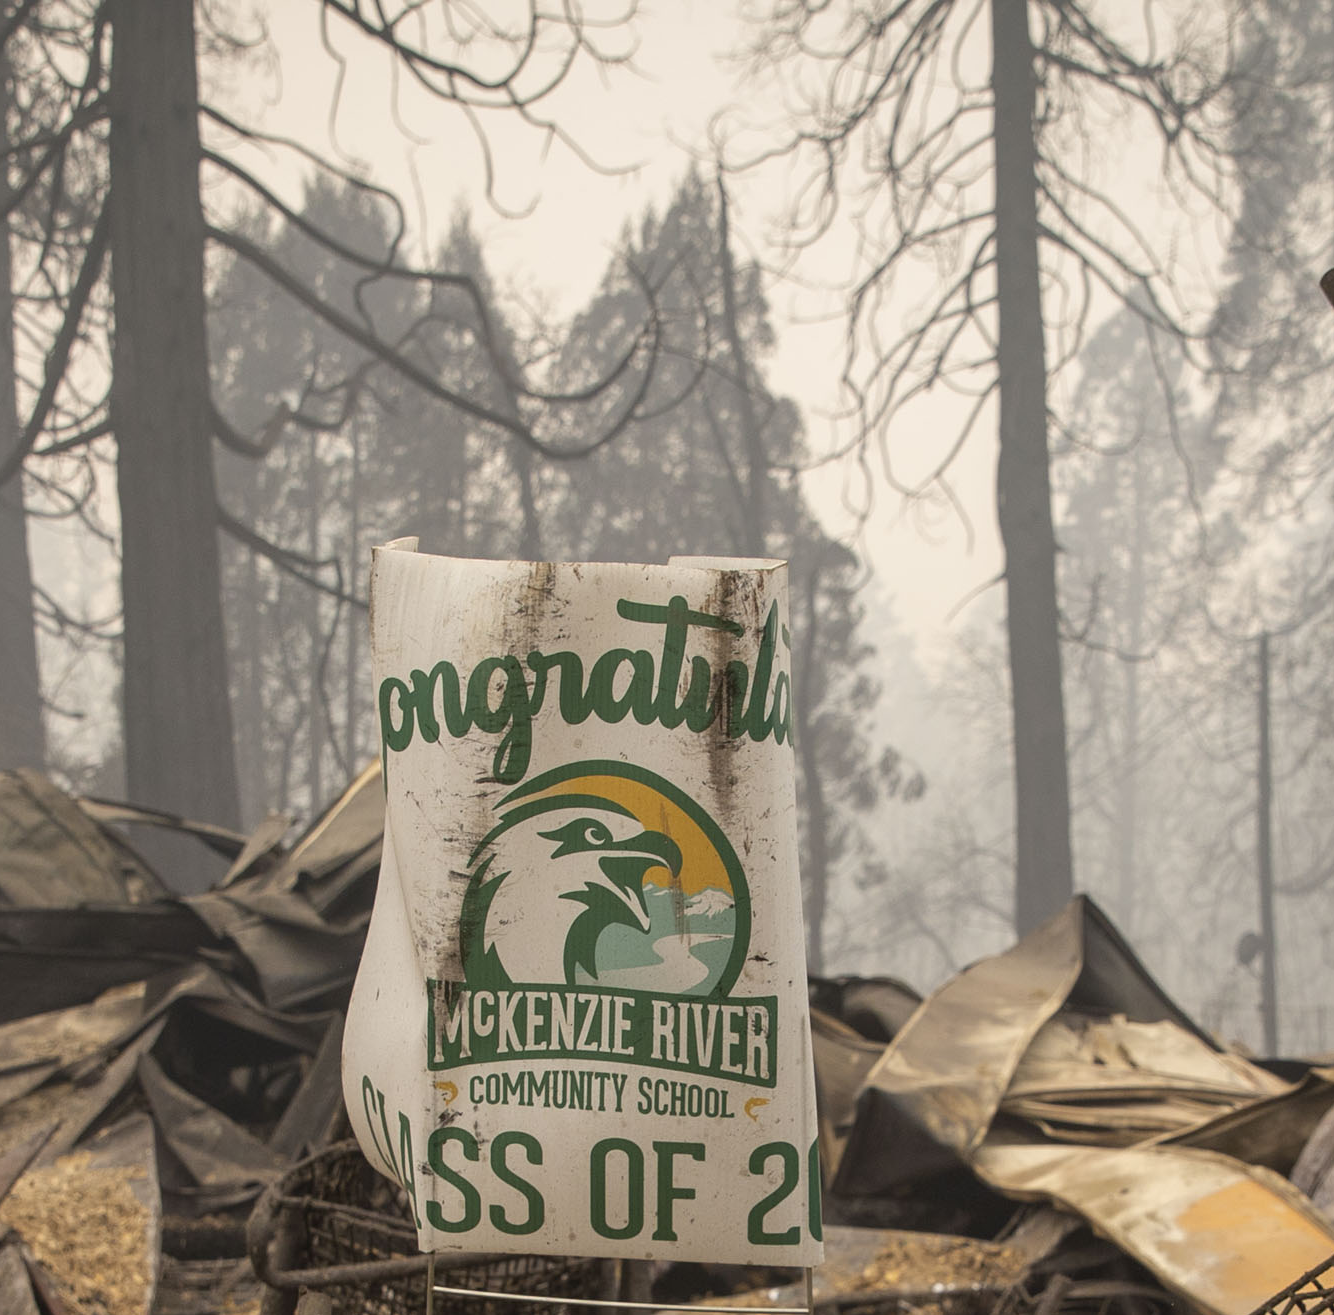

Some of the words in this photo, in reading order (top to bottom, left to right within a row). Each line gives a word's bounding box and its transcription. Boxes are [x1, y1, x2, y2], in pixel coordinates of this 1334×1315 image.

[379, 595, 794, 803] ongratula
[469, 1069, 628, 1113] COMMUNITY
[637, 1076, 735, 1119] SCHOOL
[651, 999, 771, 1081] RIVER
[362, 1075, 545, 1235] CLASS
[590, 1138, 706, 1242] OF
